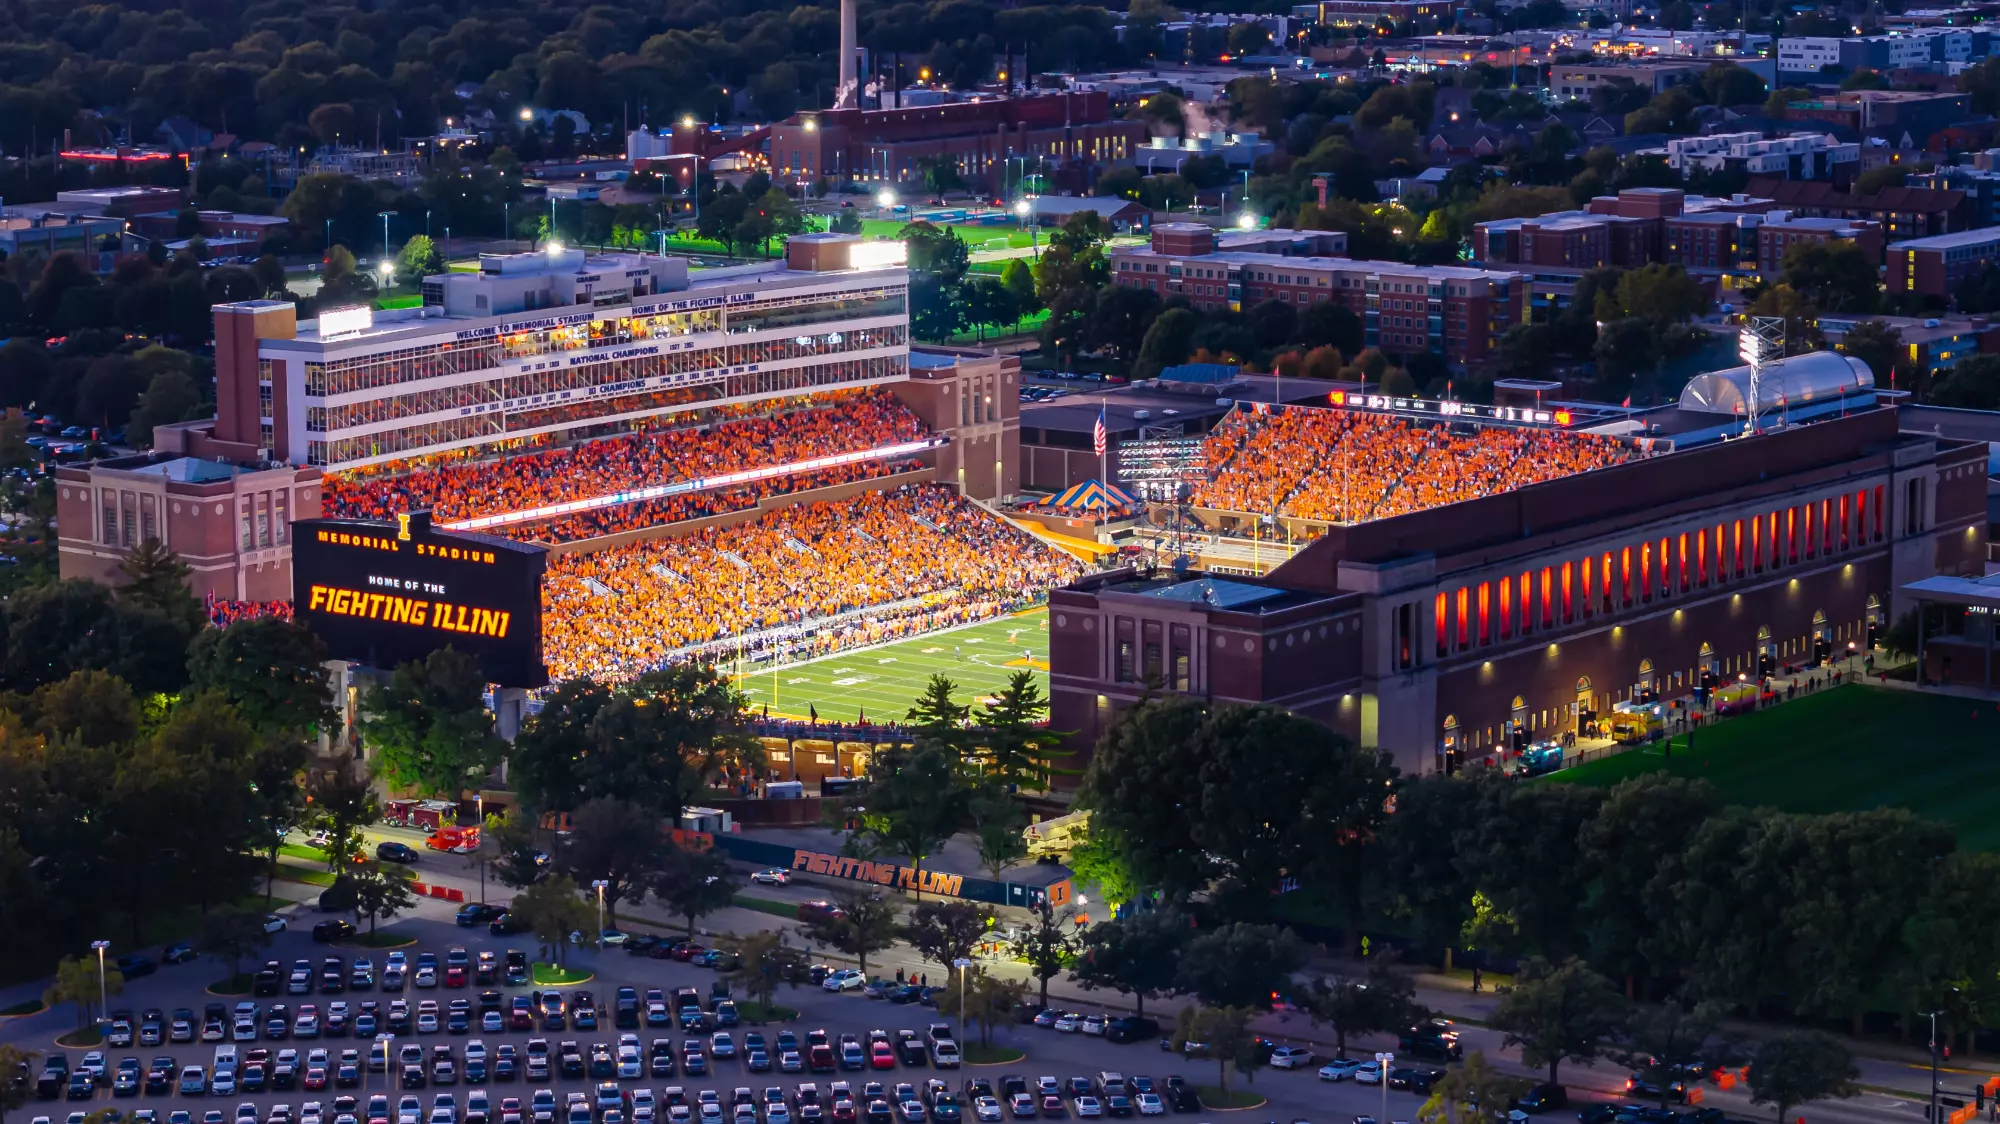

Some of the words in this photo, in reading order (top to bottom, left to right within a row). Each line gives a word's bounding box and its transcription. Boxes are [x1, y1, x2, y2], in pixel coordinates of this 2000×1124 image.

[632, 307, 655, 315] HOME
[658, 304, 669, 312] OF
[672, 301, 688, 310] THE
[690, 296, 728, 307] FIGHTING
[731, 293, 755, 301] ILLINI
[457, 327, 497, 339] WELCOME
[499, 324, 510, 333] TO
[512, 318, 556, 331] MEMORIAL
[558, 313, 595, 325] STADIUM
[570, 352, 609, 365] NATIONAL
[612, 346, 659, 359] CHAMPIONS
[600, 380, 645, 393] CHAMPIONS
[318, 531, 399, 551] MEMORIAL
[417, 544, 495, 564] STADIUM
[369, 576, 400, 588] HOME
[405, 580, 419, 590] OF
[424, 583, 446, 594] THE
[309, 585, 429, 626] FIGHTING
[432, 602, 511, 638] ILLINI
[793, 850, 895, 886] FIGHTING
[897, 866, 963, 896] ILLINI
